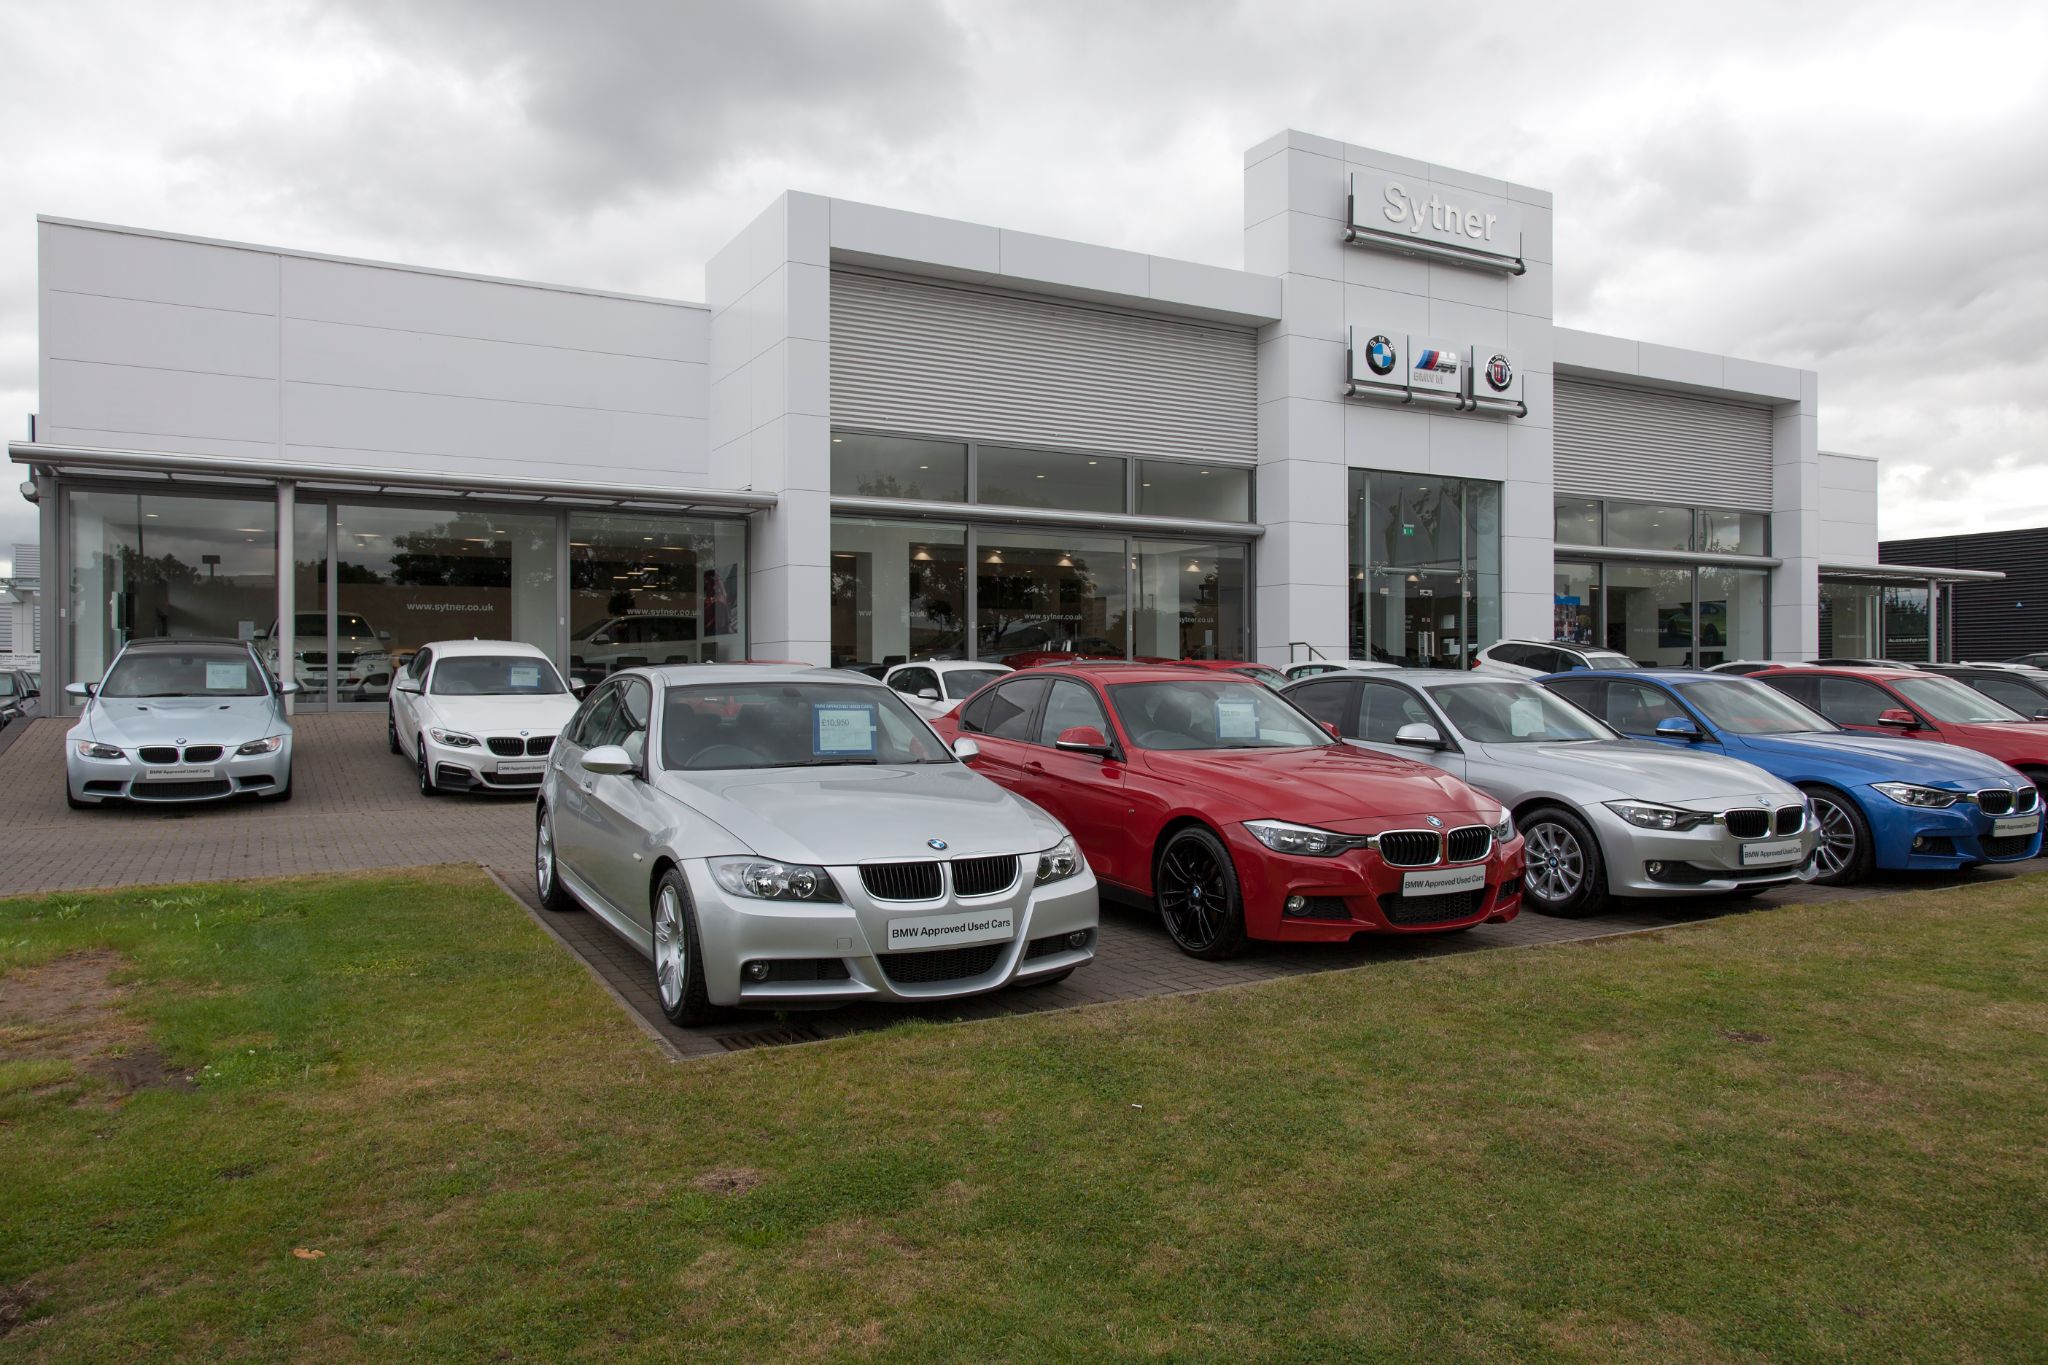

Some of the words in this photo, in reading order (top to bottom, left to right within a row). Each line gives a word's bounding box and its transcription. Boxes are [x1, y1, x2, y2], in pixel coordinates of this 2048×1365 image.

[1383, 181, 1497, 241] Sytner
[1413, 371, 1434, 384] BMW
[406, 602, 494, 612] www.sytner.co.uk
[1744, 851, 1760, 859] BMW
[1760, 850, 1783, 858] Approved
[1404, 880, 1424, 889] BMW
[1424, 877, 1456, 888] Approved
[1456, 876, 1471, 885] Used
[1471, 874, 1484, 882] Cars
[892, 927, 919, 938] BMW
[920, 923, 966, 937] Approved
[967, 920, 990, 931] Used
[990, 919, 1011, 929] Cars
